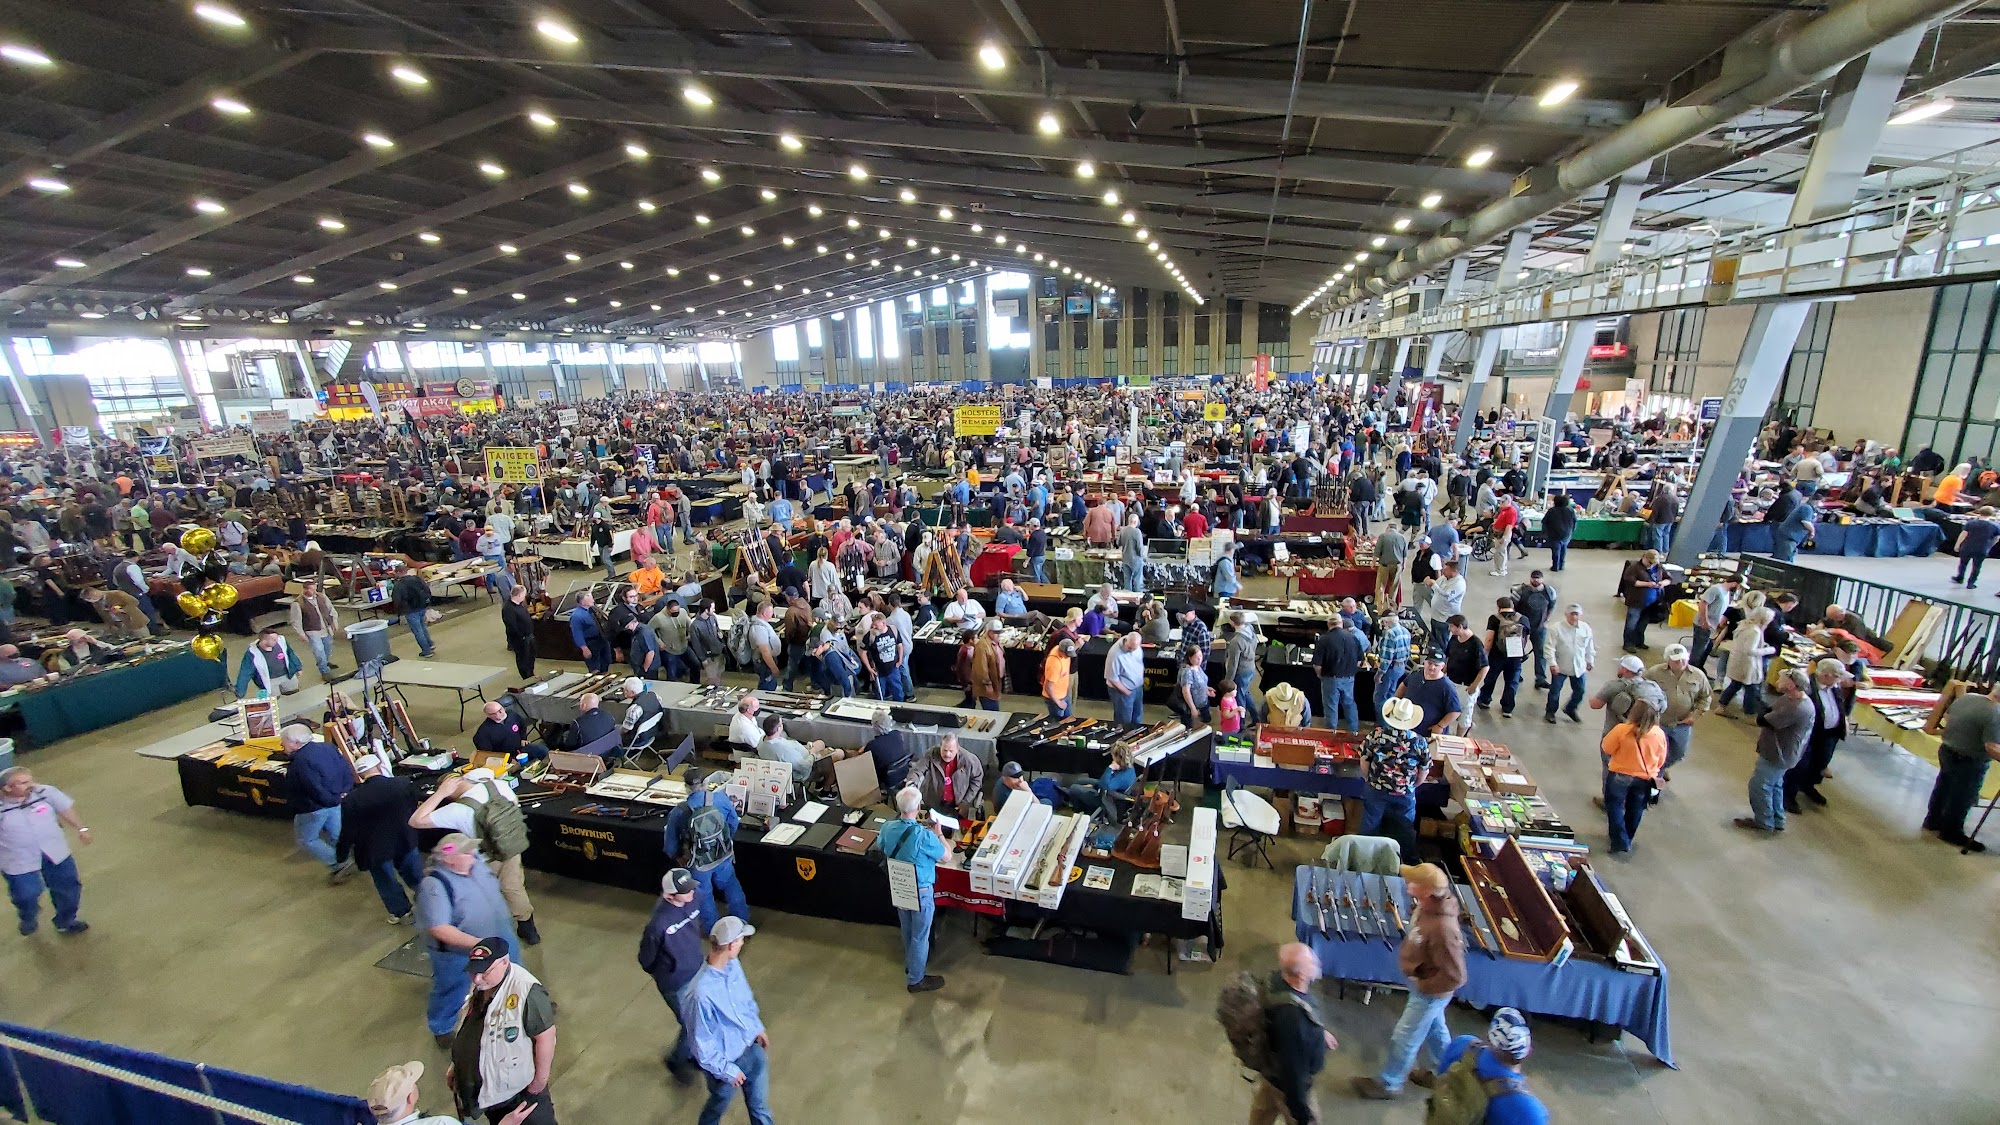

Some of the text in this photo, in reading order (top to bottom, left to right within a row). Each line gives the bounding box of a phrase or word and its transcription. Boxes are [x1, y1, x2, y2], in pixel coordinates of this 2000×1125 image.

[1729, 377, 1747, 395] 29
[961, 409, 1000, 417] HOLSTERS
[1725, 398, 1737, 415] S
[488, 451, 536, 460] TARGETS
[559, 823, 616, 843] BROWNING
